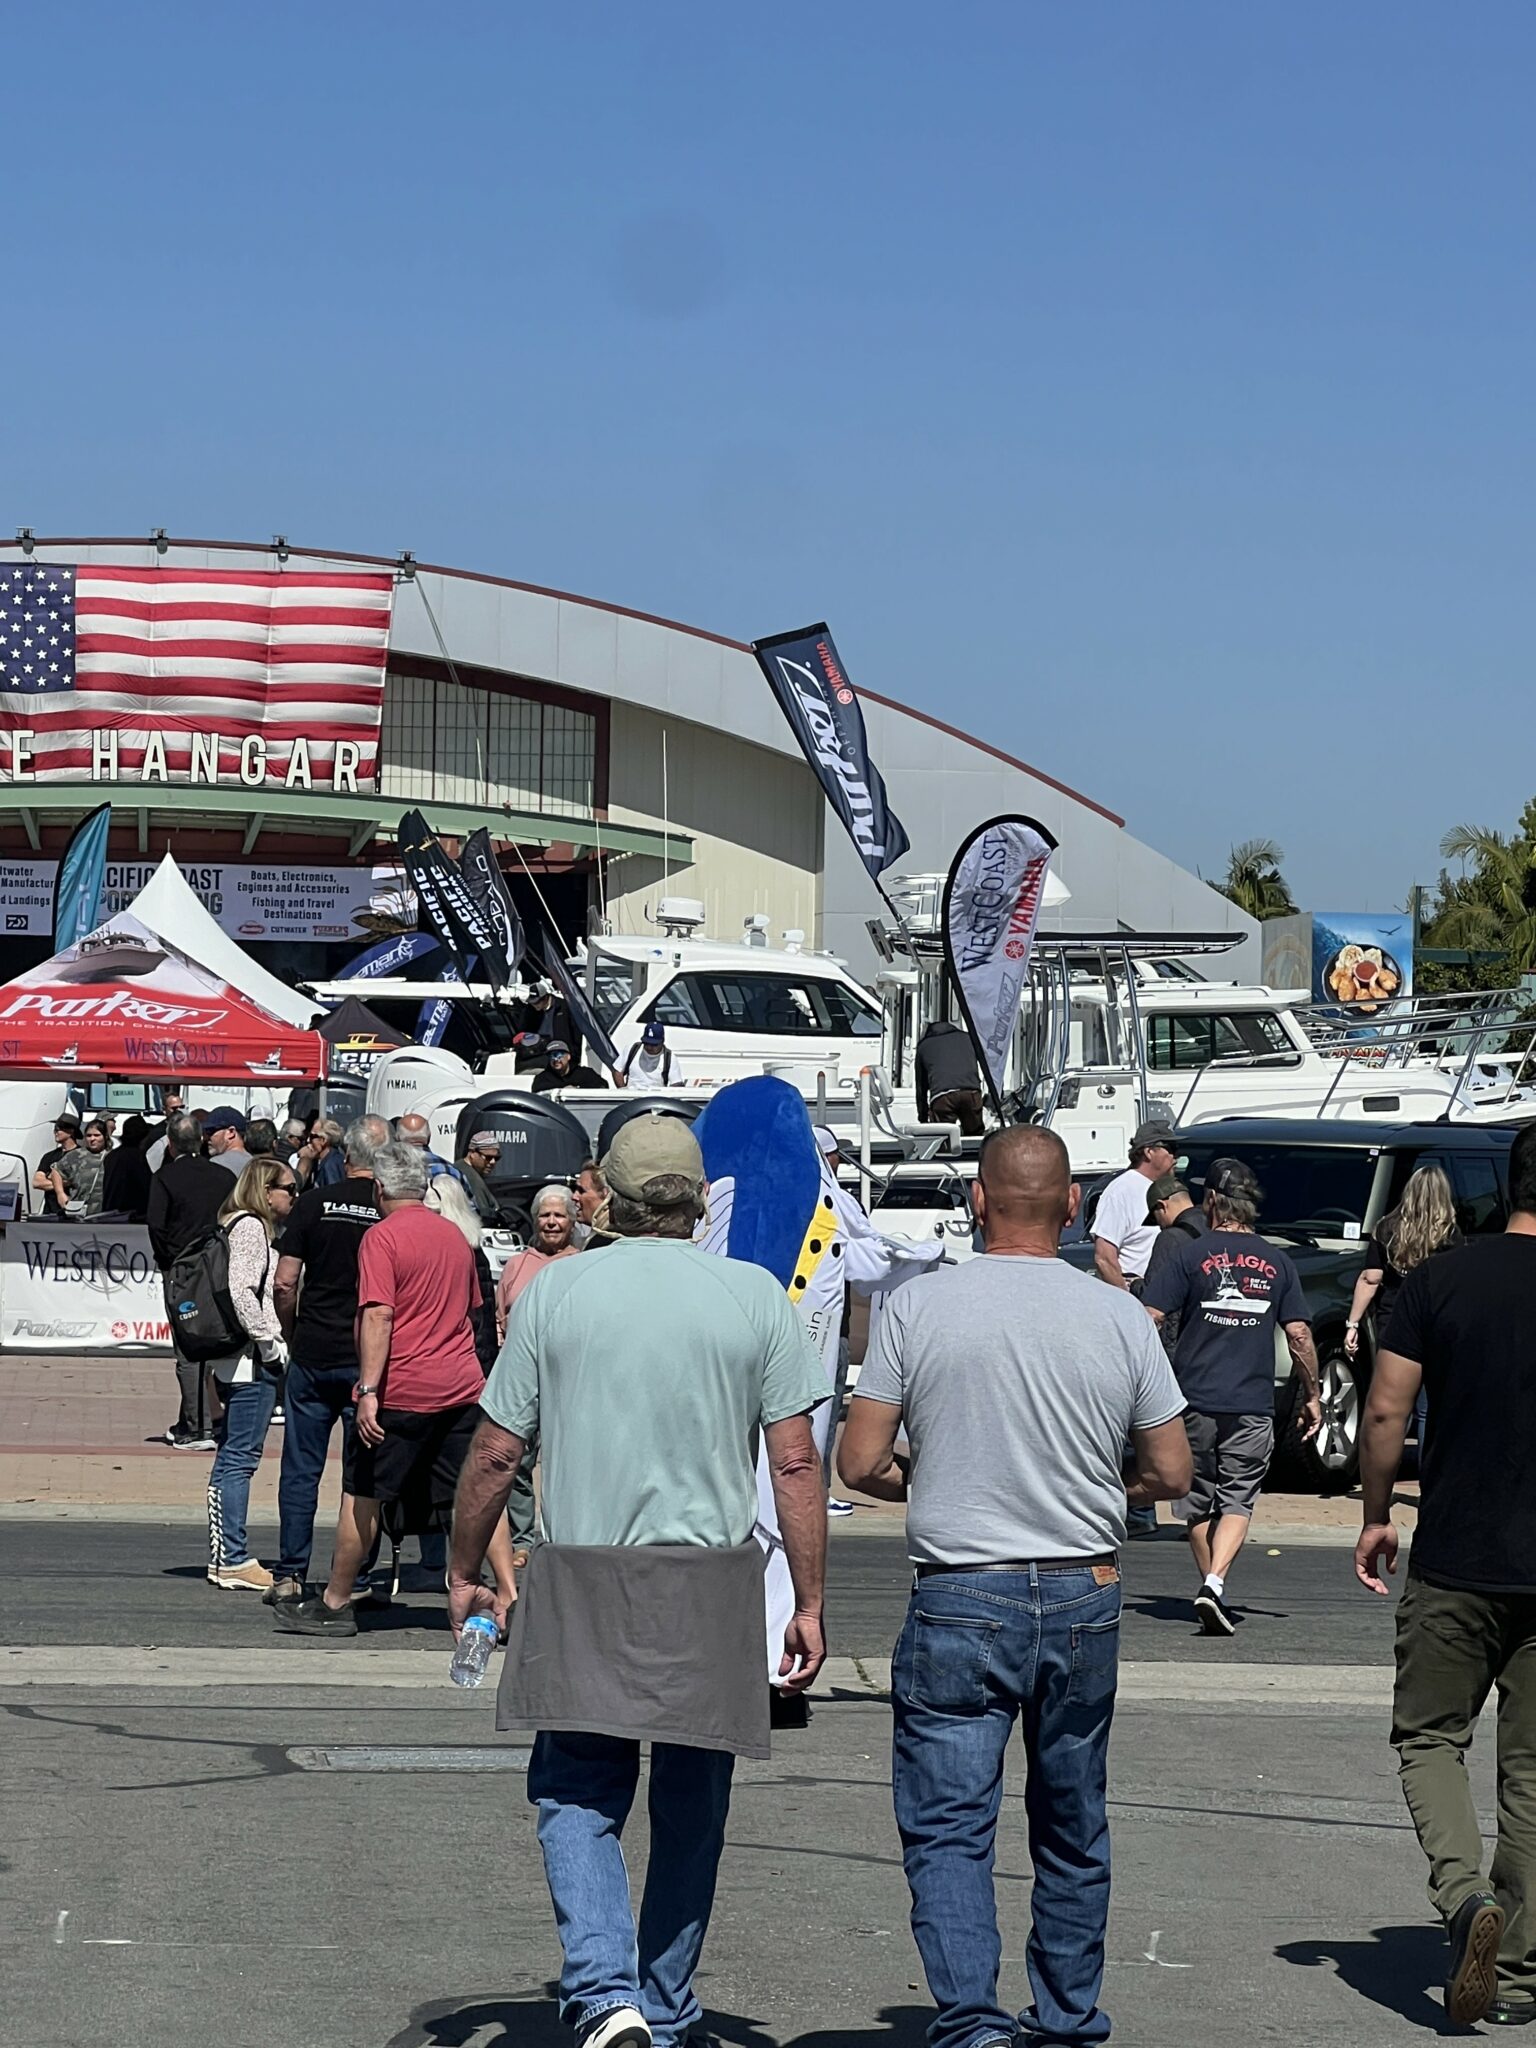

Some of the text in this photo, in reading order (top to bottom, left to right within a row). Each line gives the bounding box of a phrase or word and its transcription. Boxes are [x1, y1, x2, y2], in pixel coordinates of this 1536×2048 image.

[815, 641, 846, 691] YAMAHA
[12, 728, 362, 793] E HANGAR
[180, 868, 223, 890] AST
[250, 870, 337, 883] Boats, Electronics,
[237, 881, 350, 894] Engines and Accessories
[1008, 857, 1046, 936] YAMAHA
[8, 895, 50, 908] Landings
[252, 897, 335, 909] Fishing and Travel
[429, 864, 493, 950] PACIFIC
[447, 874, 490, 934] FREEDOM
[263, 909, 323, 920] Destinations
[270, 926, 307, 934] CUTWATER
[0, 991, 205, 1025] Parker
[35, 1019, 125, 1027] TRADITION
[1201, 1252, 1277, 1279] PELAGIC
[1204, 1312, 1261, 1327] FISHING CO.
